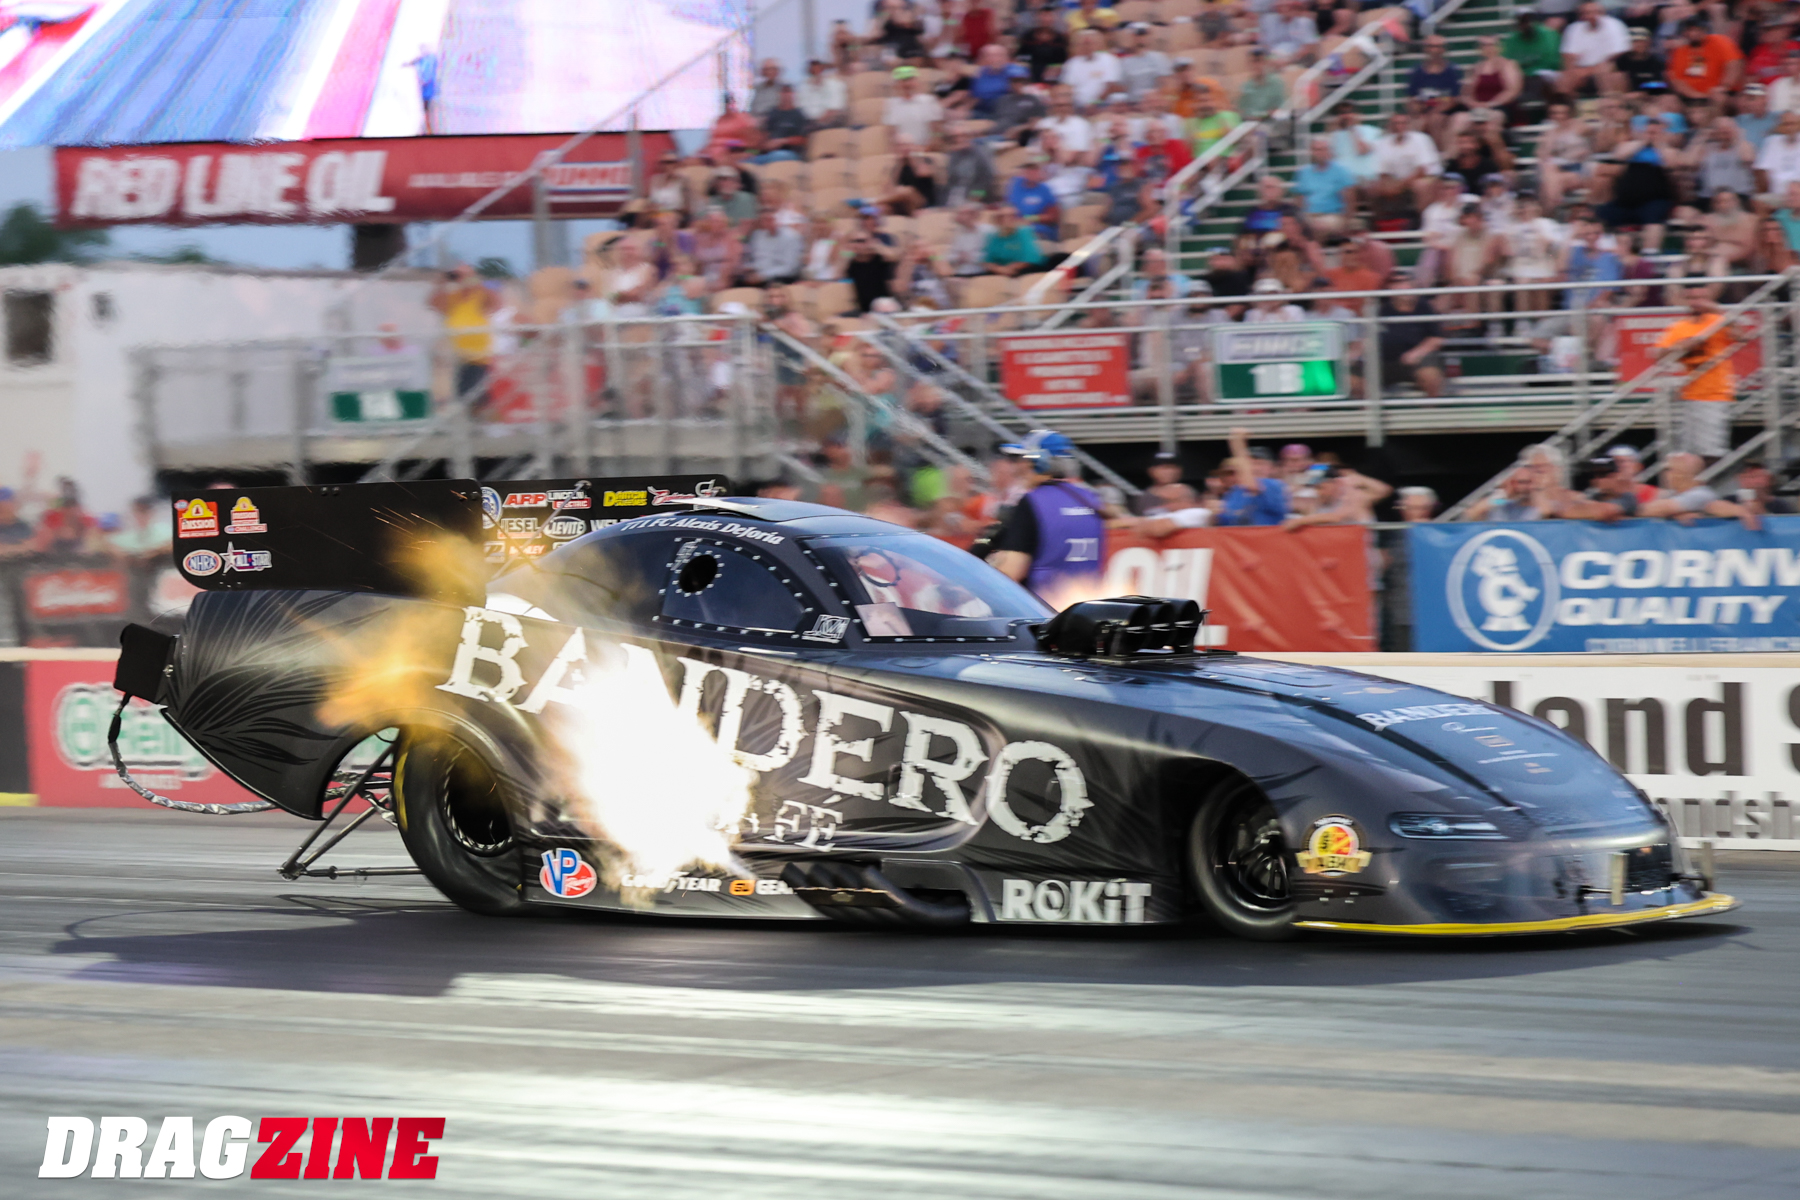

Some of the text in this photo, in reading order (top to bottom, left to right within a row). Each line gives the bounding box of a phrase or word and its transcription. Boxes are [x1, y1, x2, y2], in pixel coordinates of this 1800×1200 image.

[72, 152, 396, 217] RED LINE OIL
[506, 493, 547, 506] ARP
[668, 517, 722, 531] Alexis
[718, 522, 786, 545] DeJoria
[188, 554, 217, 572] NHRA
[1553, 595, 1788, 626] QUALITY
[541, 848, 581, 895] VP
